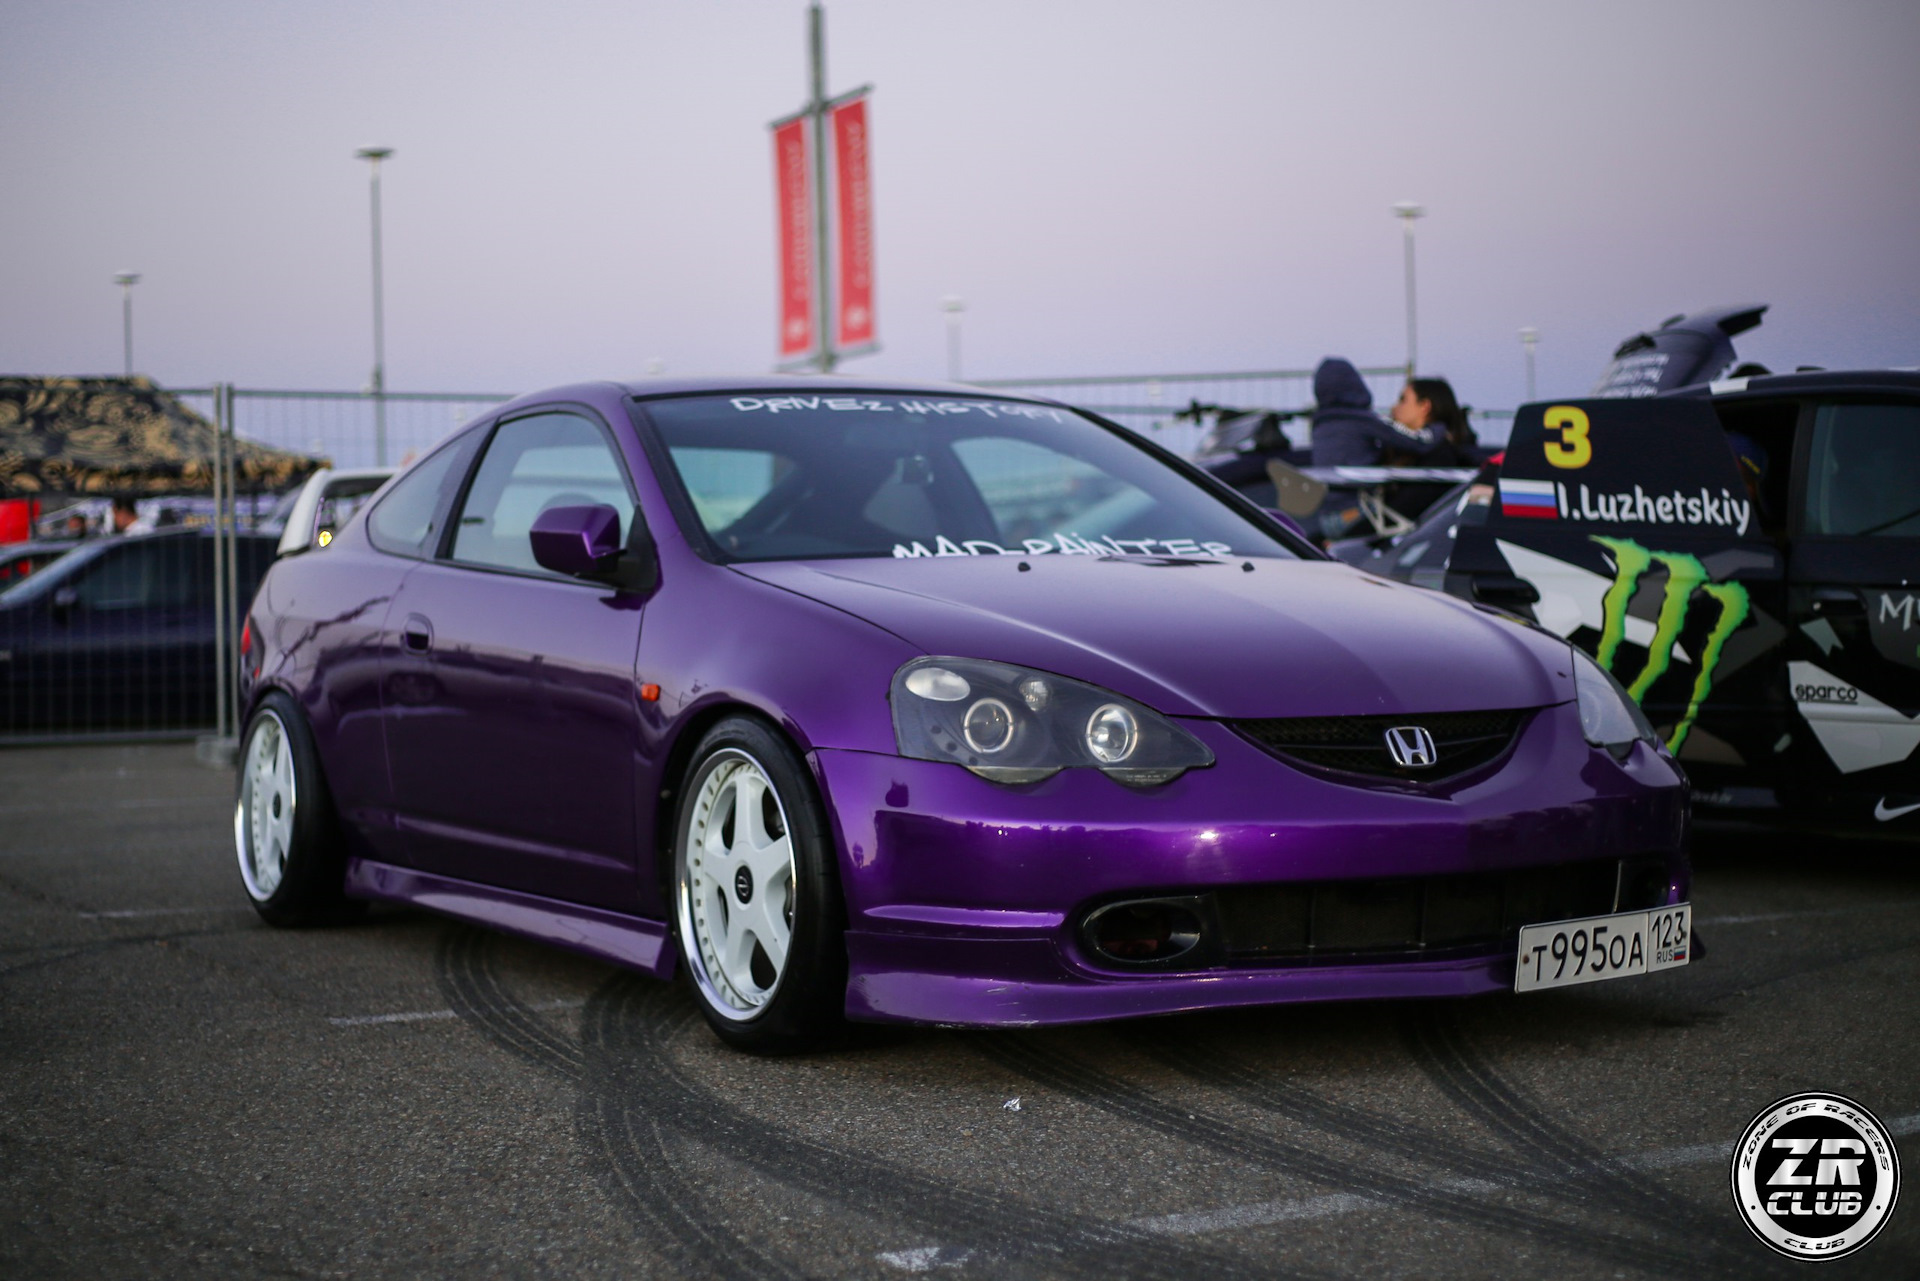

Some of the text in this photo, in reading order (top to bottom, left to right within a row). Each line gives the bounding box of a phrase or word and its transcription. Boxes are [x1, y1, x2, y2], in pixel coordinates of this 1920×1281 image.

[1542, 406, 1592, 469] 3
[1557, 482, 1751, 536] I.Luzhetskiy
[1795, 683, 1859, 702] sparco
[1651, 911, 1685, 949] 123
[1656, 949, 1674, 964] RUS
